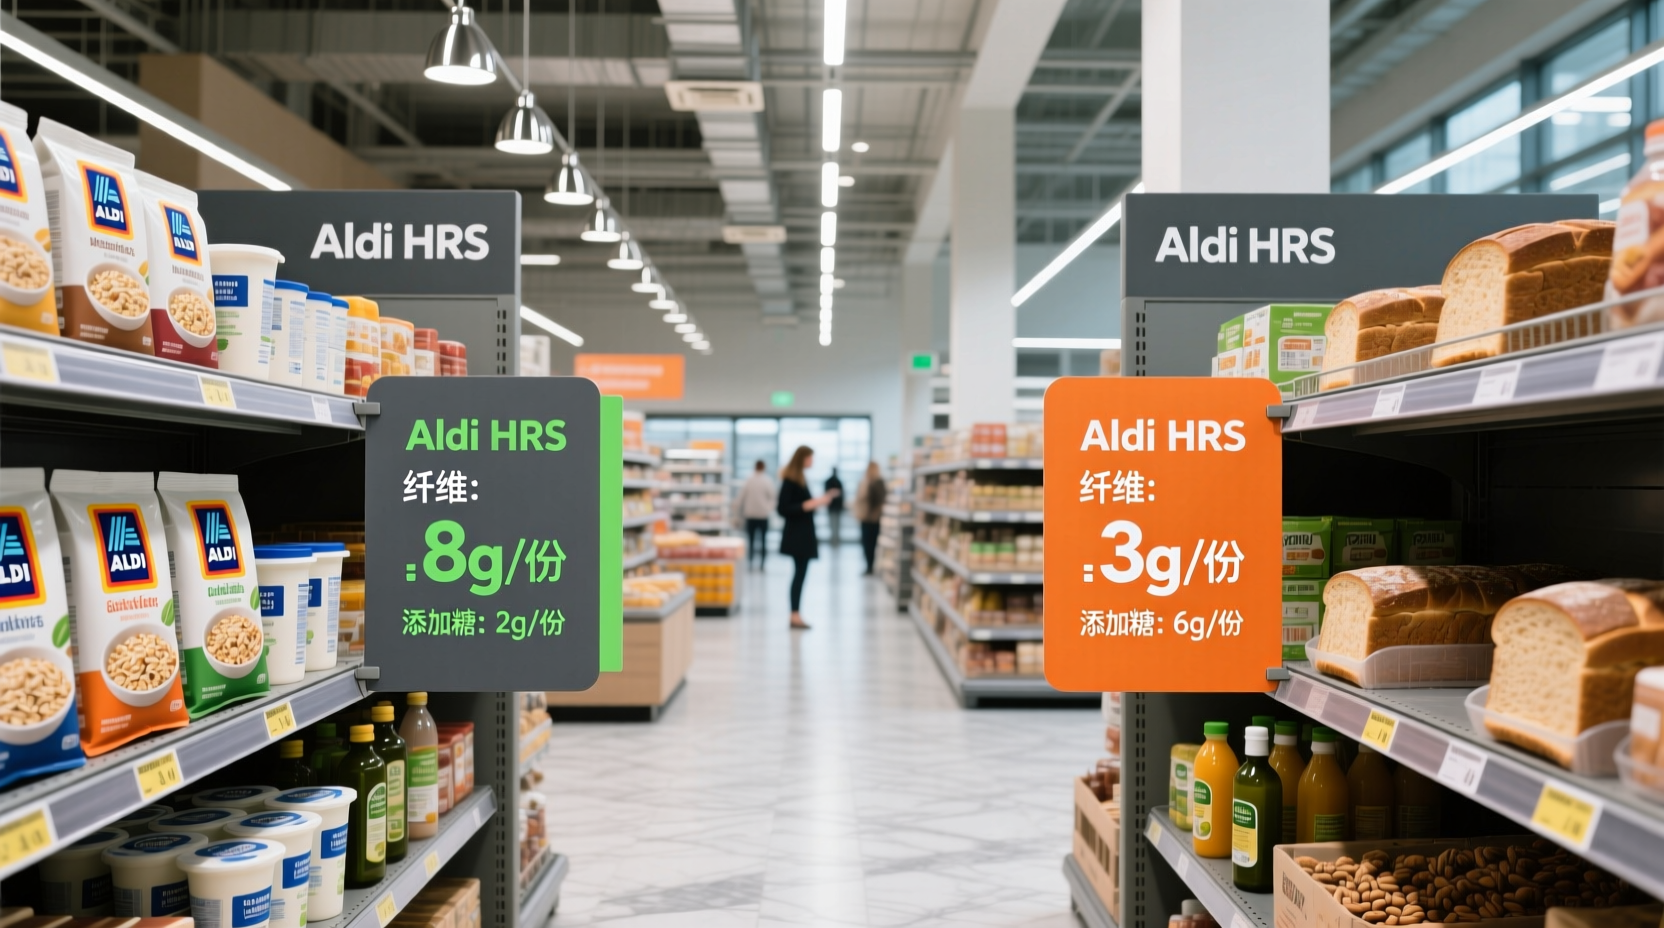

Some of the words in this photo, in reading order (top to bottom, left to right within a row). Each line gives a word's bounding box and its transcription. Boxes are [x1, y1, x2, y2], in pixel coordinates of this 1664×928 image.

[95, 205, 124, 223] ALDI
[310, 221, 393, 260] Aldi
[403, 223, 490, 261] HRS
[1154, 225, 1238, 263] Aldi
[1249, 227, 1336, 264] HRS
[405, 418, 479, 451] Aldi
[490, 419, 567, 451] HRS
[1079, 418, 1155, 452] Aldi
[1168, 419, 1246, 452] HRS
[402, 469, 479, 504] 纤维:
[1079, 469, 1155, 504] 纤维:
[110, 552, 146, 572] ALDI
[206, 546, 236, 563] ALDI
